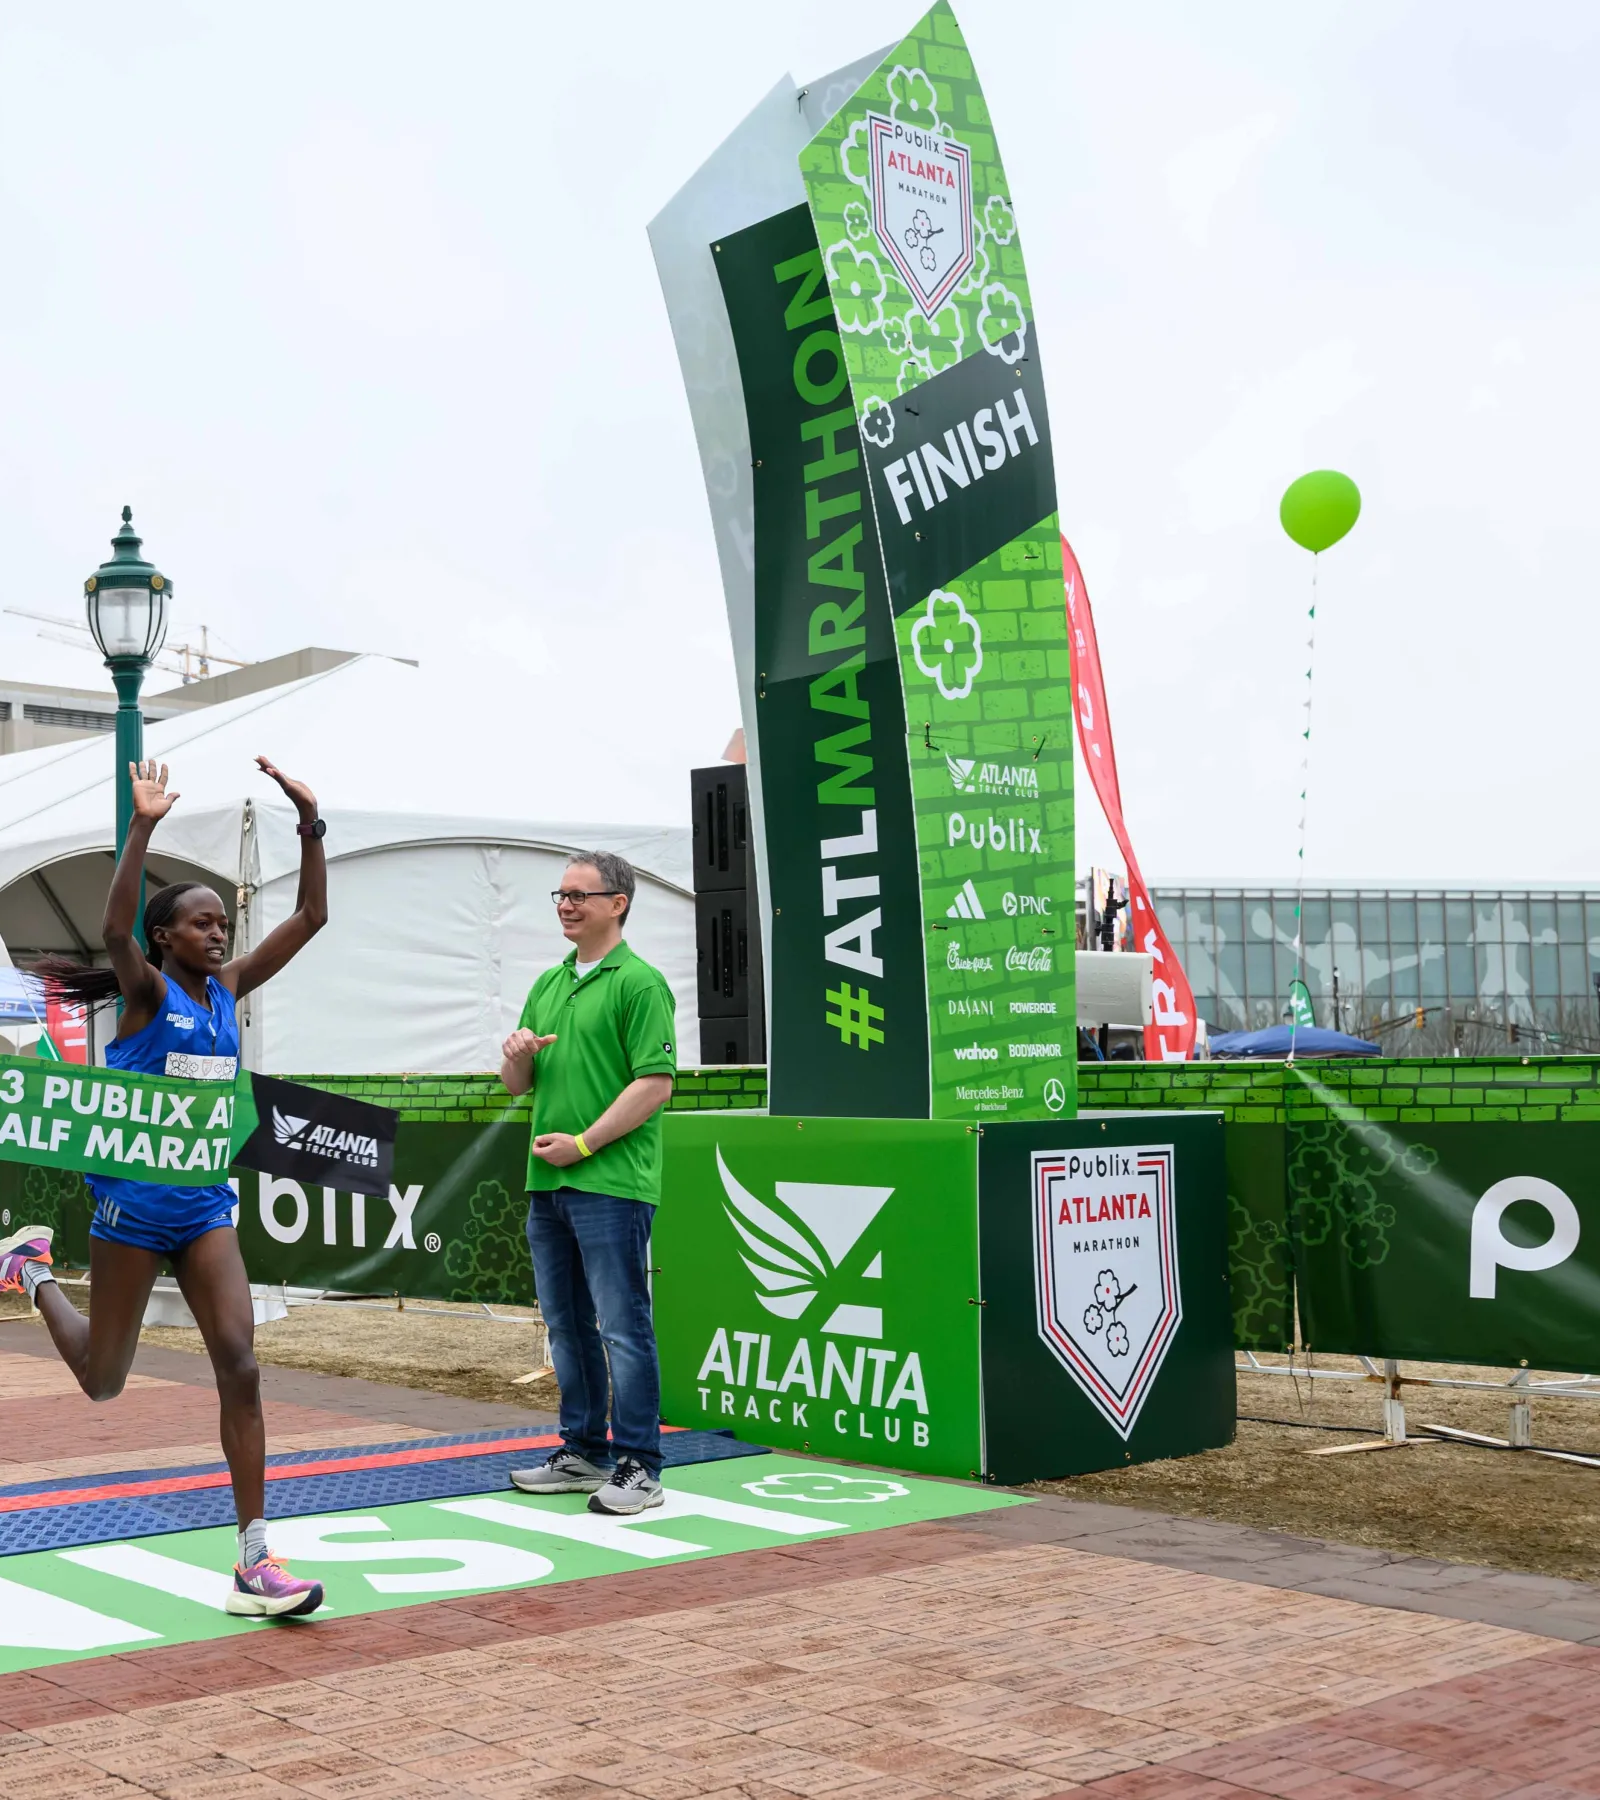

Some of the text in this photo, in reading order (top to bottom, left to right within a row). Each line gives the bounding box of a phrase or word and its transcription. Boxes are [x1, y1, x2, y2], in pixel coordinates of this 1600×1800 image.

[894, 123, 941, 155] Publix
[887, 149, 956, 190] ATLANTA
[897, 181, 948, 206] MARATHON
[883, 387, 1040, 526] FINISH
[978, 762, 1039, 789] ATLANTA
[979, 784, 1039, 798] TRACK CLUB
[948, 812, 1043, 854] Publix
[1018, 895, 1053, 916] PNC
[1005, 945, 1053, 972] Coca-Cola
[948, 996, 995, 1019] DASANI
[1009, 1002, 1058, 1014] POWERADE
[953, 1041, 999, 1060] wahoo
[1008, 1043, 1062, 1058] BODYARMOR
[42, 1074, 197, 1130] PUBLIX
[955, 1085, 1025, 1100] Mercedes-Benz
[307, 1124, 379, 1158] ATLANTA
[305, 1143, 378, 1168] TRACK CLUB
[1069, 1154, 1131, 1180] Publix
[1058, 1191, 1153, 1226] ATLANTA
[1072, 1235, 1141, 1255] MARATHON
[696, 1327, 930, 1415] ATLANTA
[697, 1387, 930, 1448] TRACK CLUB
